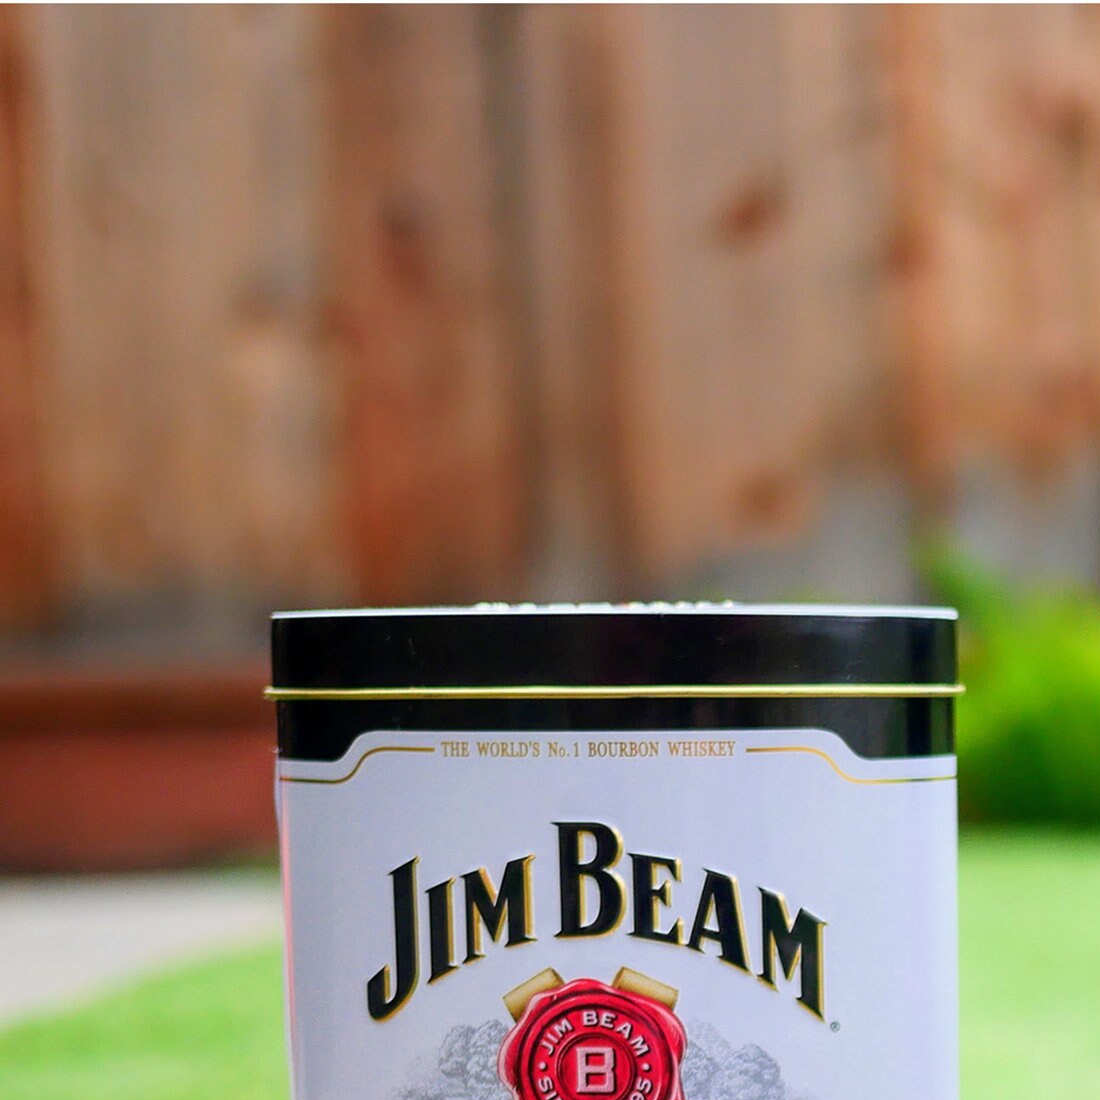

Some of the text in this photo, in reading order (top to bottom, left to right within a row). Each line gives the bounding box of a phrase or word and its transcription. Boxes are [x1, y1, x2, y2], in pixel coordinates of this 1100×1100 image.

[441, 741, 470, 757] THE
[476, 741, 540, 757] WORLD'S
[588, 741, 660, 757] BOURBON
[667, 741, 736, 757] WHISKEY
[366, 820, 830, 1025] JIM BEAM
[541, 1009, 650, 1058] JIM BEAM
[576, 1046, 617, 1094] B
